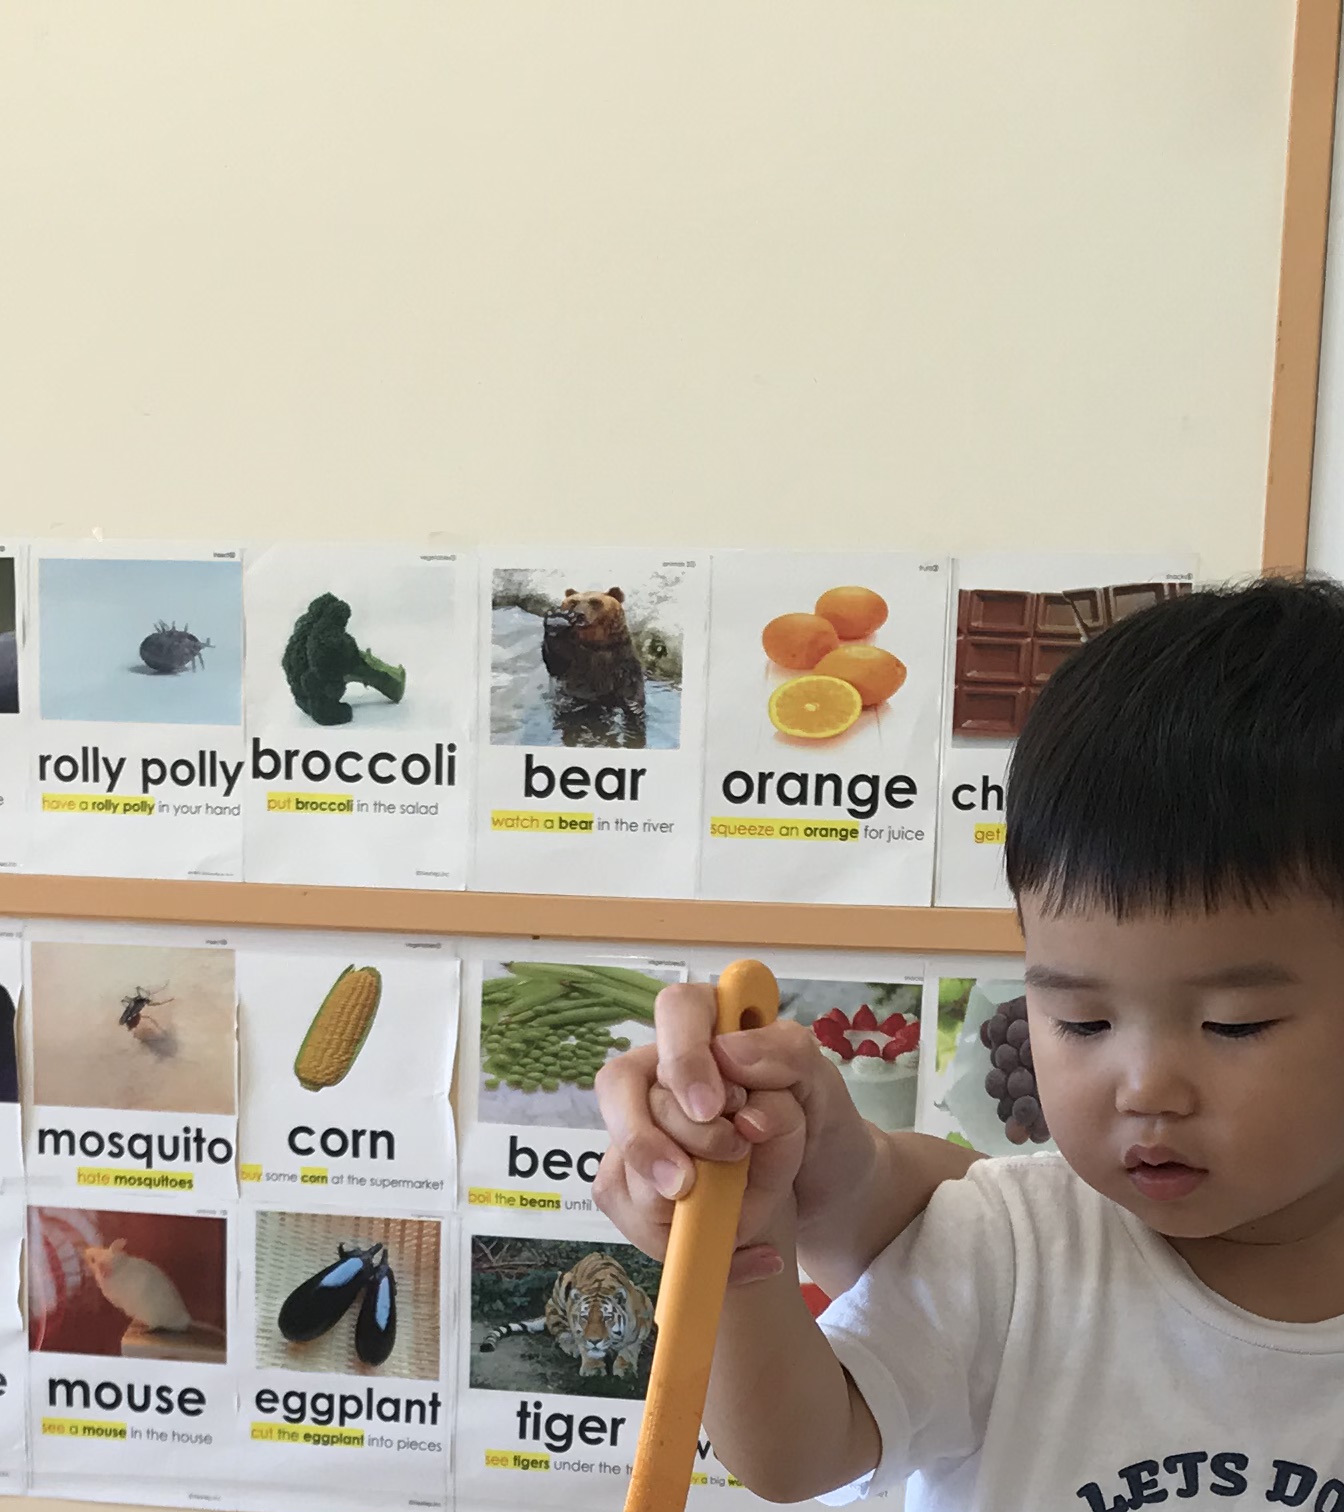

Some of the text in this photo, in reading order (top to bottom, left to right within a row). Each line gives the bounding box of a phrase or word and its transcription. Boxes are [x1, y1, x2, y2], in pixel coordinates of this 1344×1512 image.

[39, 746, 245, 797] rolly polly
[252, 737, 457, 786] broccoli
[524, 754, 647, 801] bear
[722, 770, 917, 819] orange
[79, 801, 88, 811] a
[91, 799, 120, 814] rolly
[124, 800, 155, 816] polly
[157, 801, 170, 813] in
[173, 805, 202, 816] your
[205, 803, 241, 816] hand
[295, 798, 354, 812] broccoli
[357, 800, 369, 812] in
[373, 800, 396, 814] the
[399, 802, 439, 815] salad
[491, 816, 675, 833] watch a bear in the river
[710, 824, 925, 843] squeeze an orange for juice
[974, 828, 1000, 844] get
[38, 1126, 233, 1169] mosquito
[288, 1126, 394, 1160] corn
[508, 1135, 605, 1183] bea
[114, 1174, 193, 1190] mosquitoes
[265, 1173, 298, 1183] some
[301, 1174, 327, 1185] corn
[331, 1174, 344, 1184] at
[347, 1174, 367, 1186] the
[370, 1178, 444, 1190] supermarket
[495, 1192, 516, 1206] the
[519, 1195, 561, 1209] beans
[564, 1199, 594, 1211] until
[48, 1378, 206, 1416] mouse
[255, 1387, 441, 1427] eggplant
[69, 1425, 78, 1435] a
[81, 1425, 127, 1440] mouse
[130, 1427, 142, 1440] in
[146, 1428, 168, 1442] the
[172, 1430, 213, 1445] house
[516, 1401, 626, 1453] tiger
[277, 1429, 299, 1441] the
[303, 1432, 364, 1449] eggplant
[368, 1434, 394, 1448] into
[397, 1437, 442, 1452] pieces
[513, 1455, 550, 1471] tigers
[553, 1460, 595, 1473] under
[599, 1461, 621, 1475] the
